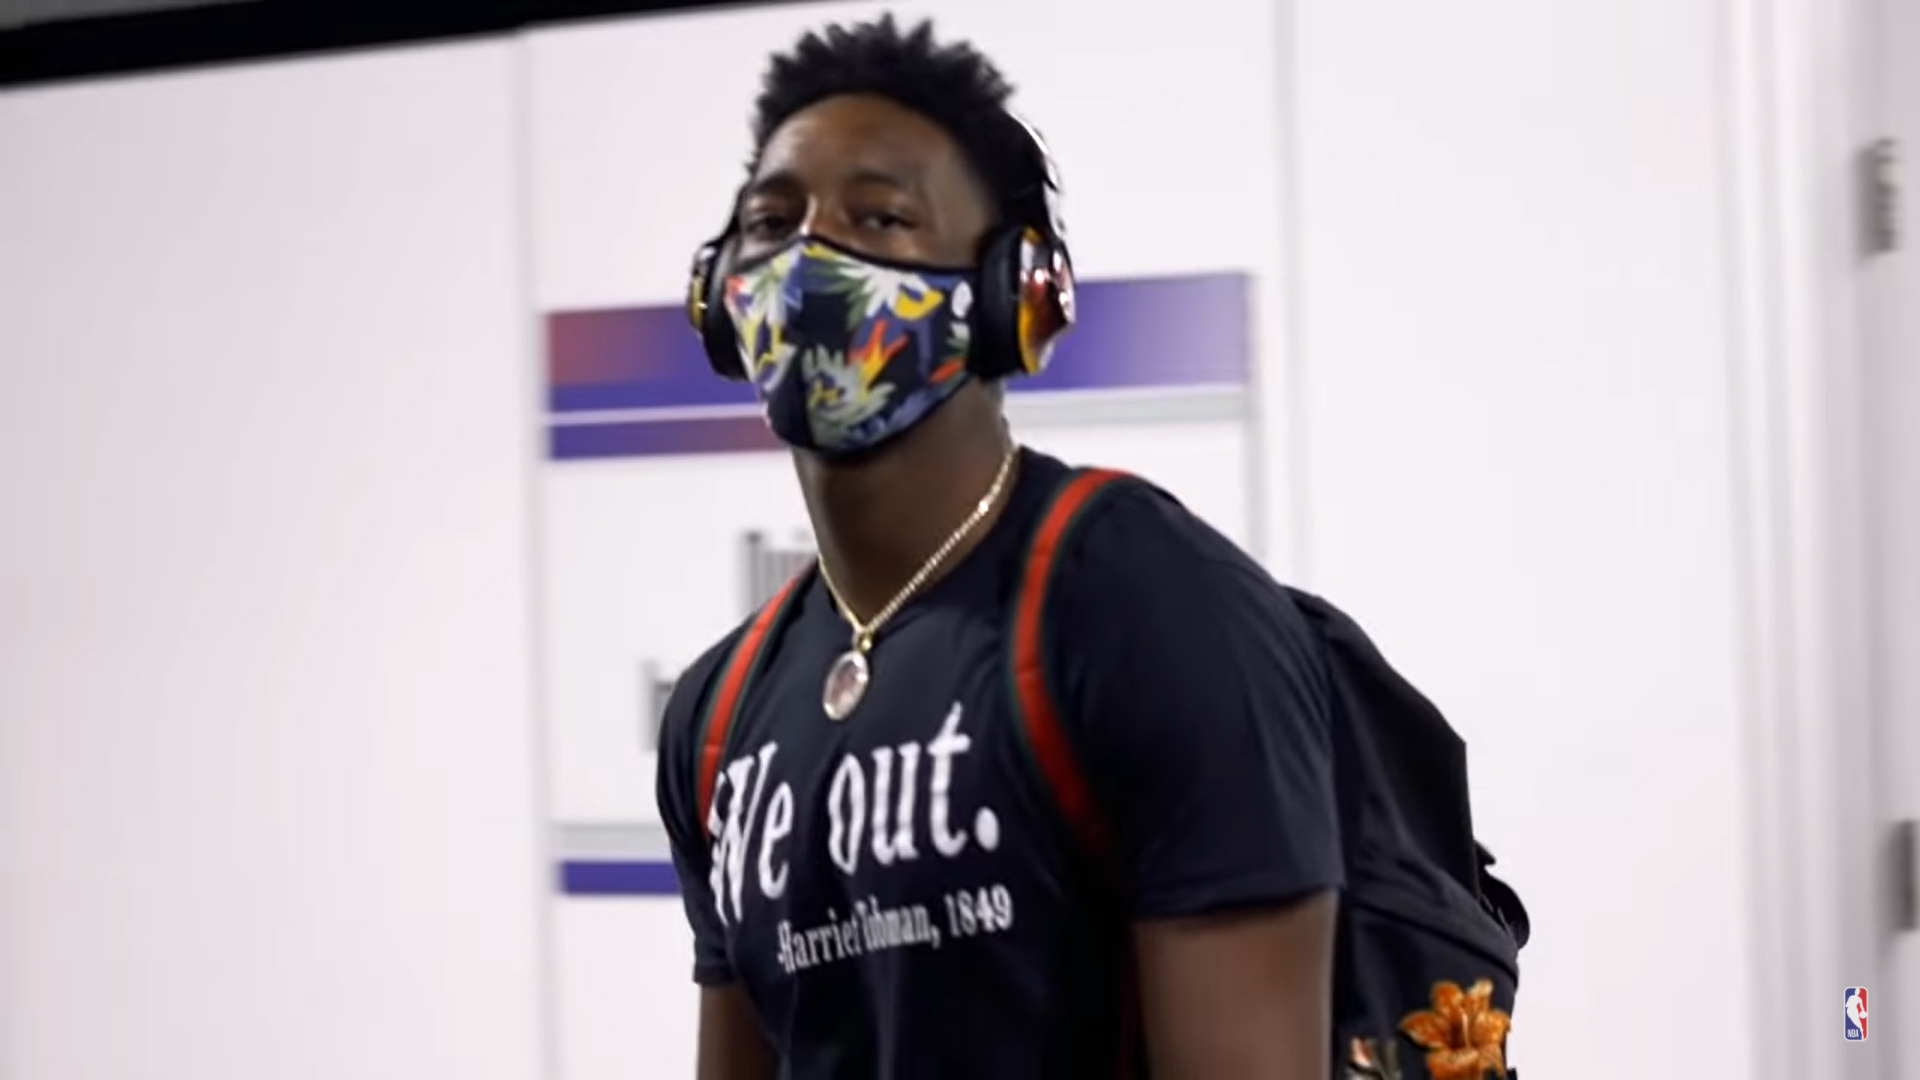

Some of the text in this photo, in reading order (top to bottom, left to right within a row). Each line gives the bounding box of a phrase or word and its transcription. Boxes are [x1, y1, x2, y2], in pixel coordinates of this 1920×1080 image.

[707, 741, 793, 926] We
[828, 701, 999, 875] out.
[945, 884, 1013, 938] 1849
